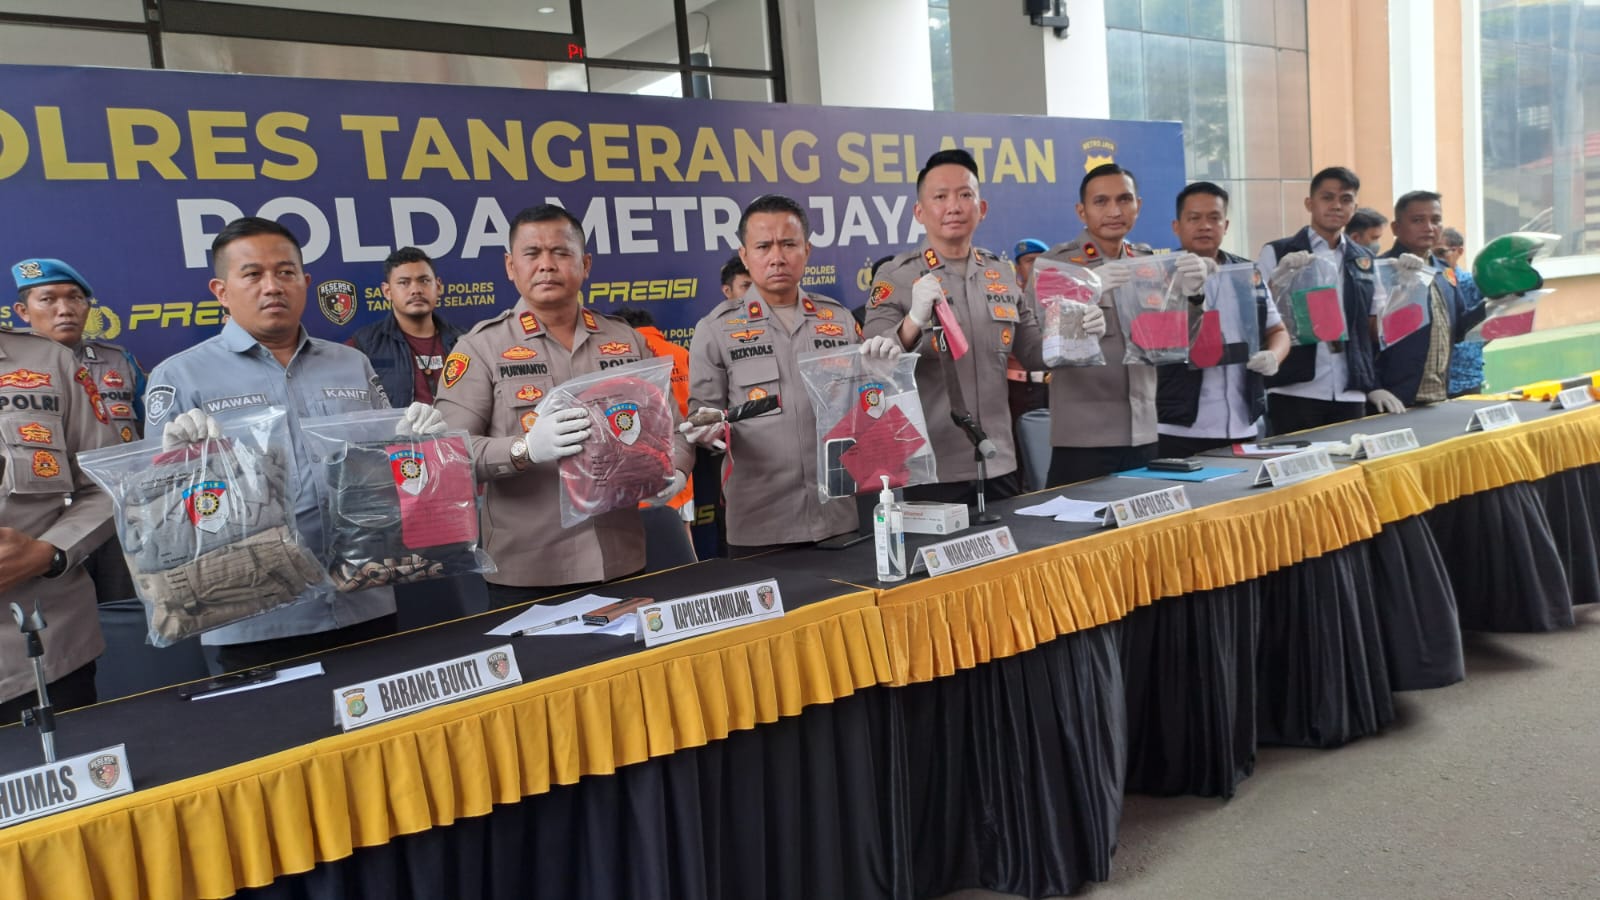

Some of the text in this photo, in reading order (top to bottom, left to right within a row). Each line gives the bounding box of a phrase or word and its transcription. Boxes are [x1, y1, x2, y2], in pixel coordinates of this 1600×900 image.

[342, 114, 821, 185] TANGERANG
[544, 195, 744, 255] METR
[804, 265, 836, 275] POLRES
[448, 282, 495, 294] POLRES
[802, 275, 836, 286] SELATAN
[588, 278, 698, 304] PRESISI
[987, 294, 1016, 305] POLRI
[444, 294, 496, 307] SELATAN
[500, 362, 548, 378] PURWANTO
[0, 394, 60, 412] POLRI
[207, 394, 262, 412] WAWAN
[325, 389, 368, 400] KANIT
[1128, 491, 1175, 519] KAPOLRES
[943, 534, 996, 566] WAKAPOLRES
[671, 589, 754, 630] KAPOLSEK PAMULANG
[378, 659, 483, 713] BARANG BUKTI
[0, 765, 78, 819] HUMAS
